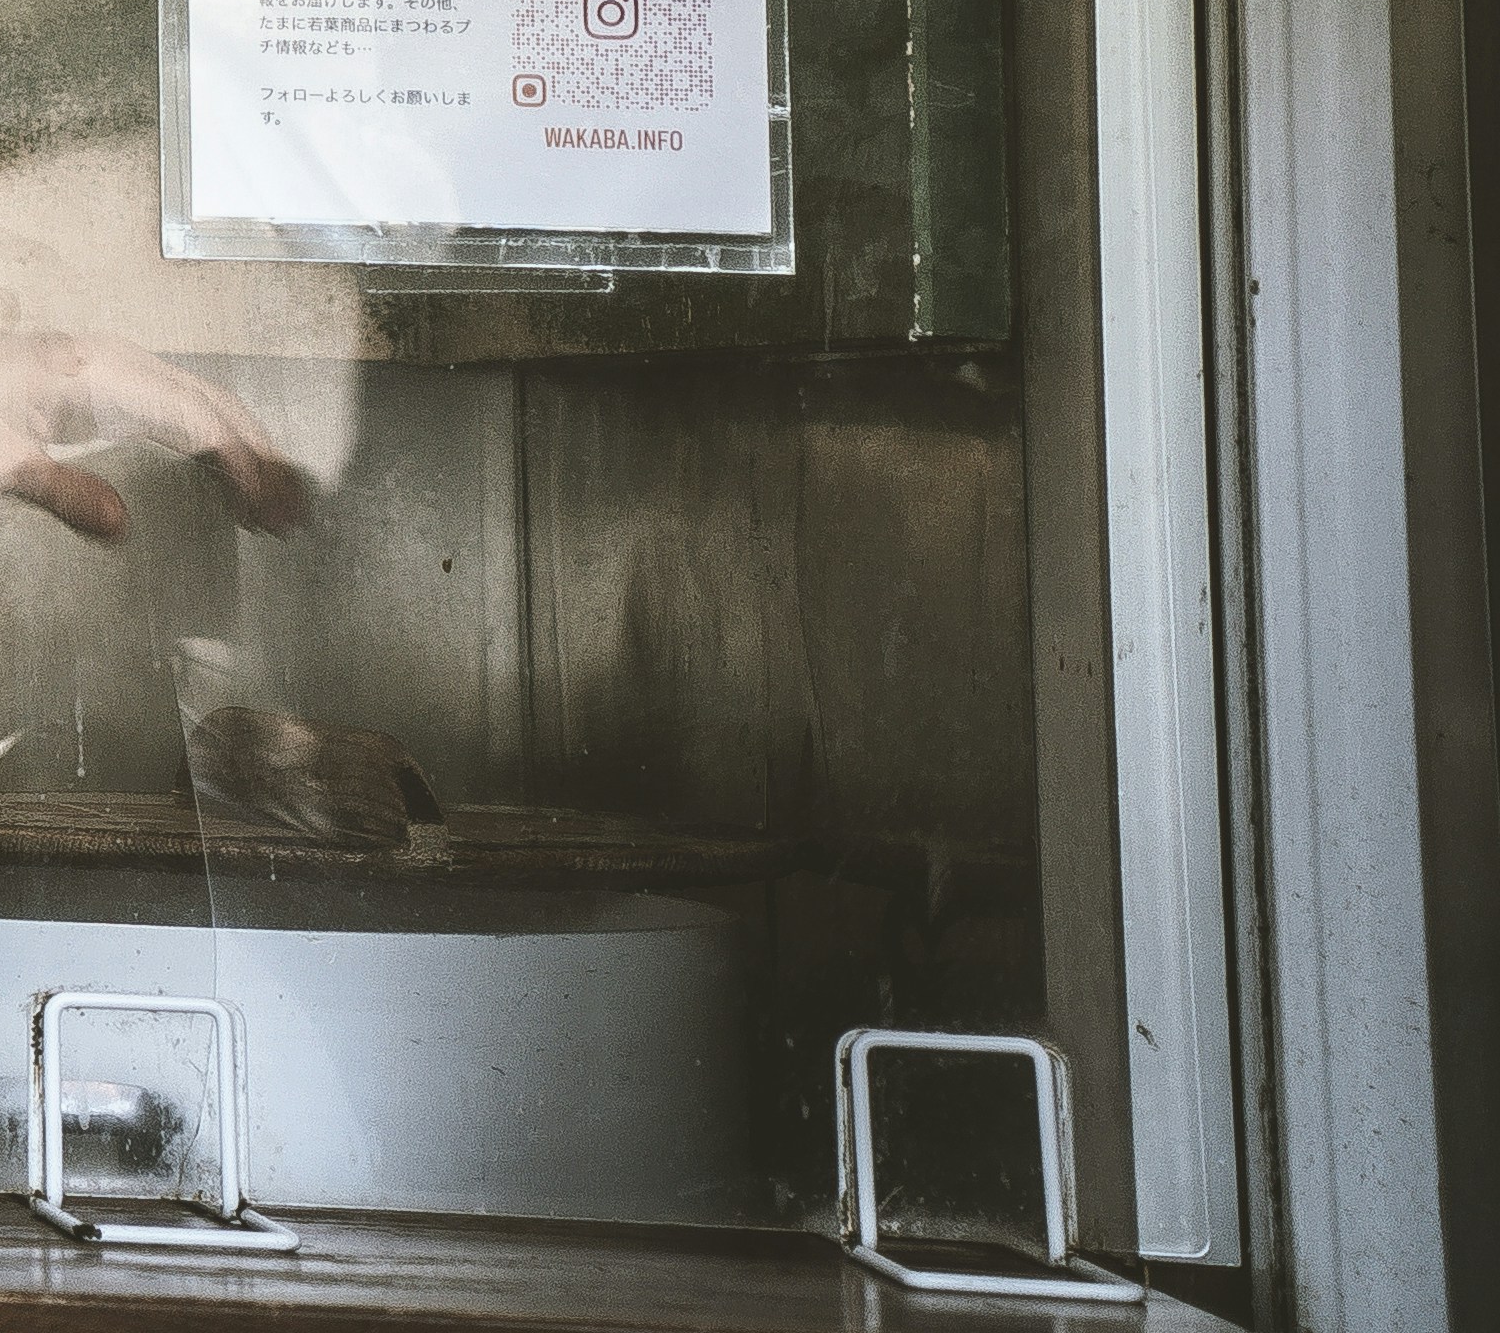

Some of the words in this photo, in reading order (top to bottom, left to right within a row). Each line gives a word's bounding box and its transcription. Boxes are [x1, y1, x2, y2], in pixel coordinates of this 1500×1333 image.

[259, 87, 472, 106] フォローよろしくお願いしま
[543, 126, 684, 153] WAKABA.INFO
